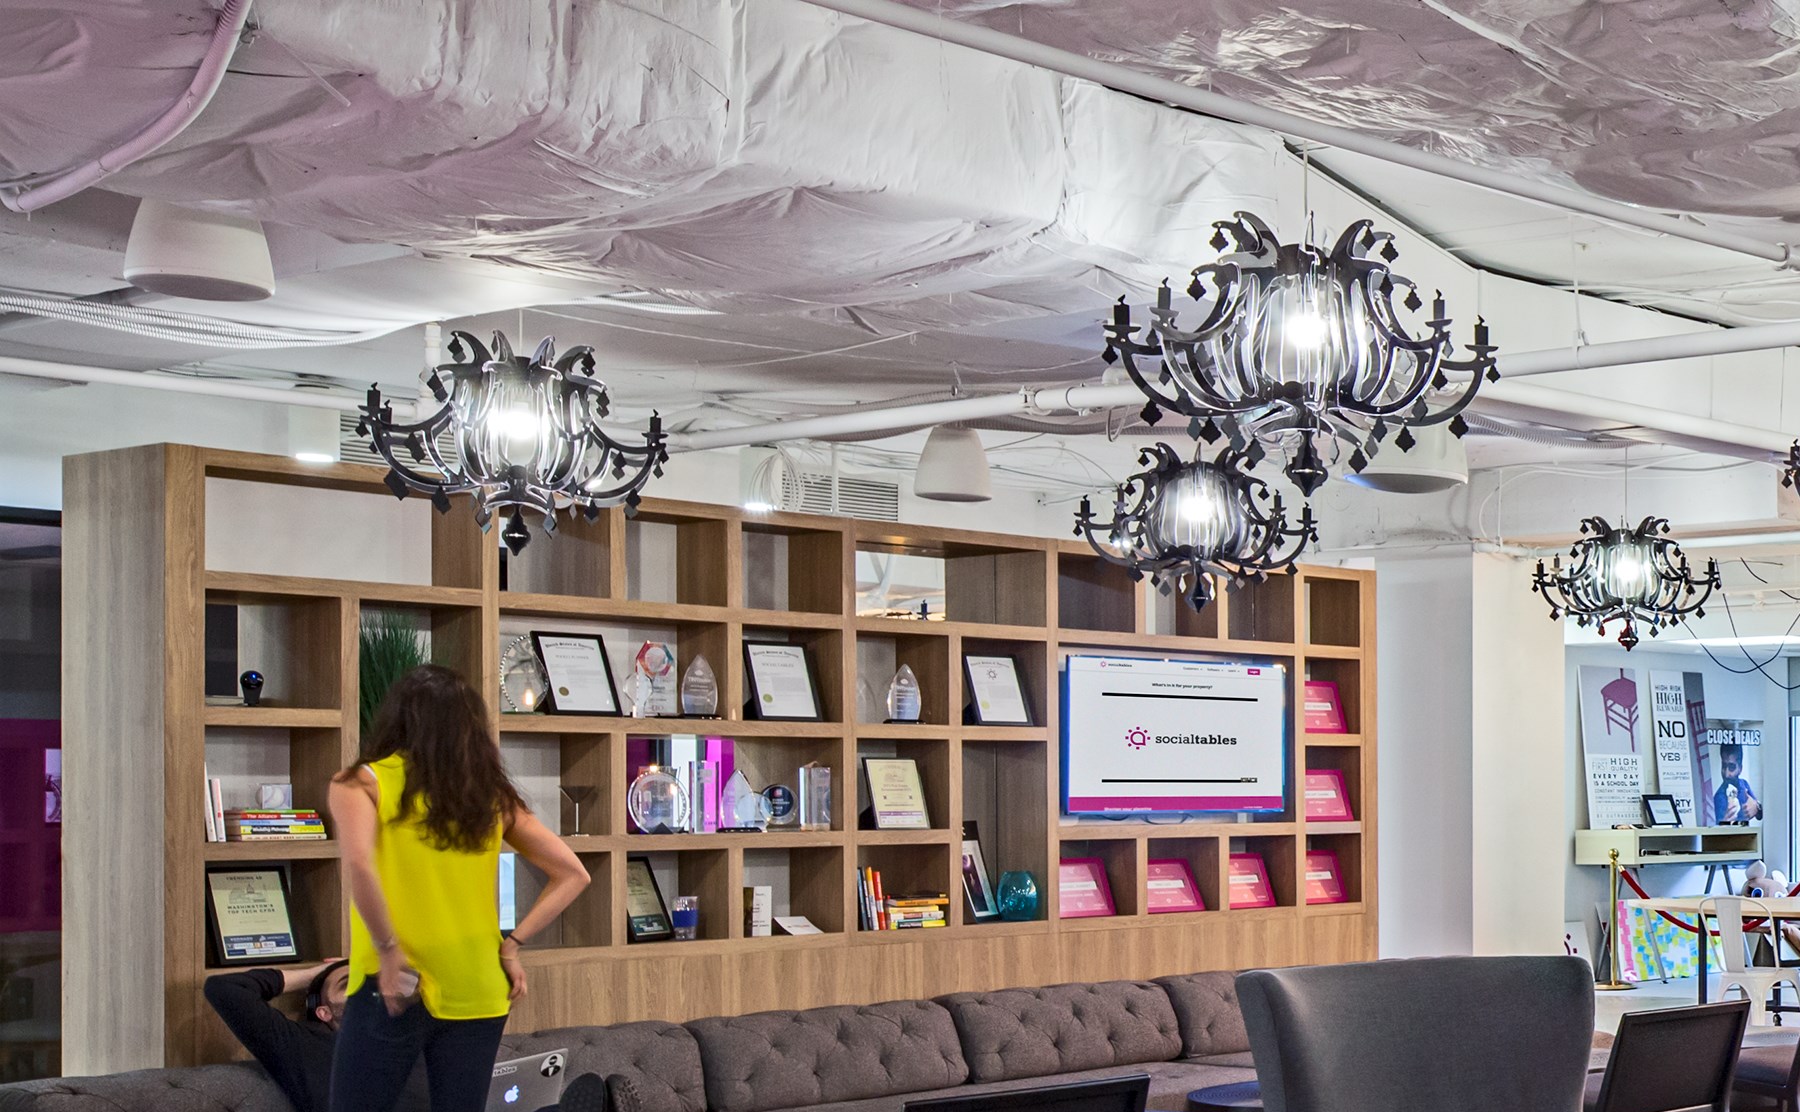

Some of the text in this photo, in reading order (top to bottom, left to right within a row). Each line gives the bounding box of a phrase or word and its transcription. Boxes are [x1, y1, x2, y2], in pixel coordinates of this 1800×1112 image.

[1656, 692, 1682, 705] HIGH
[1657, 720, 1686, 738] NO
[1155, 733, 1237, 746] socialtables
[1707, 729, 1760, 746] CLOSE DEALS
[1659, 740, 1687, 750] BECAUSE
[1610, 758, 1638, 766] HIGH
[1660, 752, 1681, 761] YES
[1675, 799, 1692, 807] RTY
